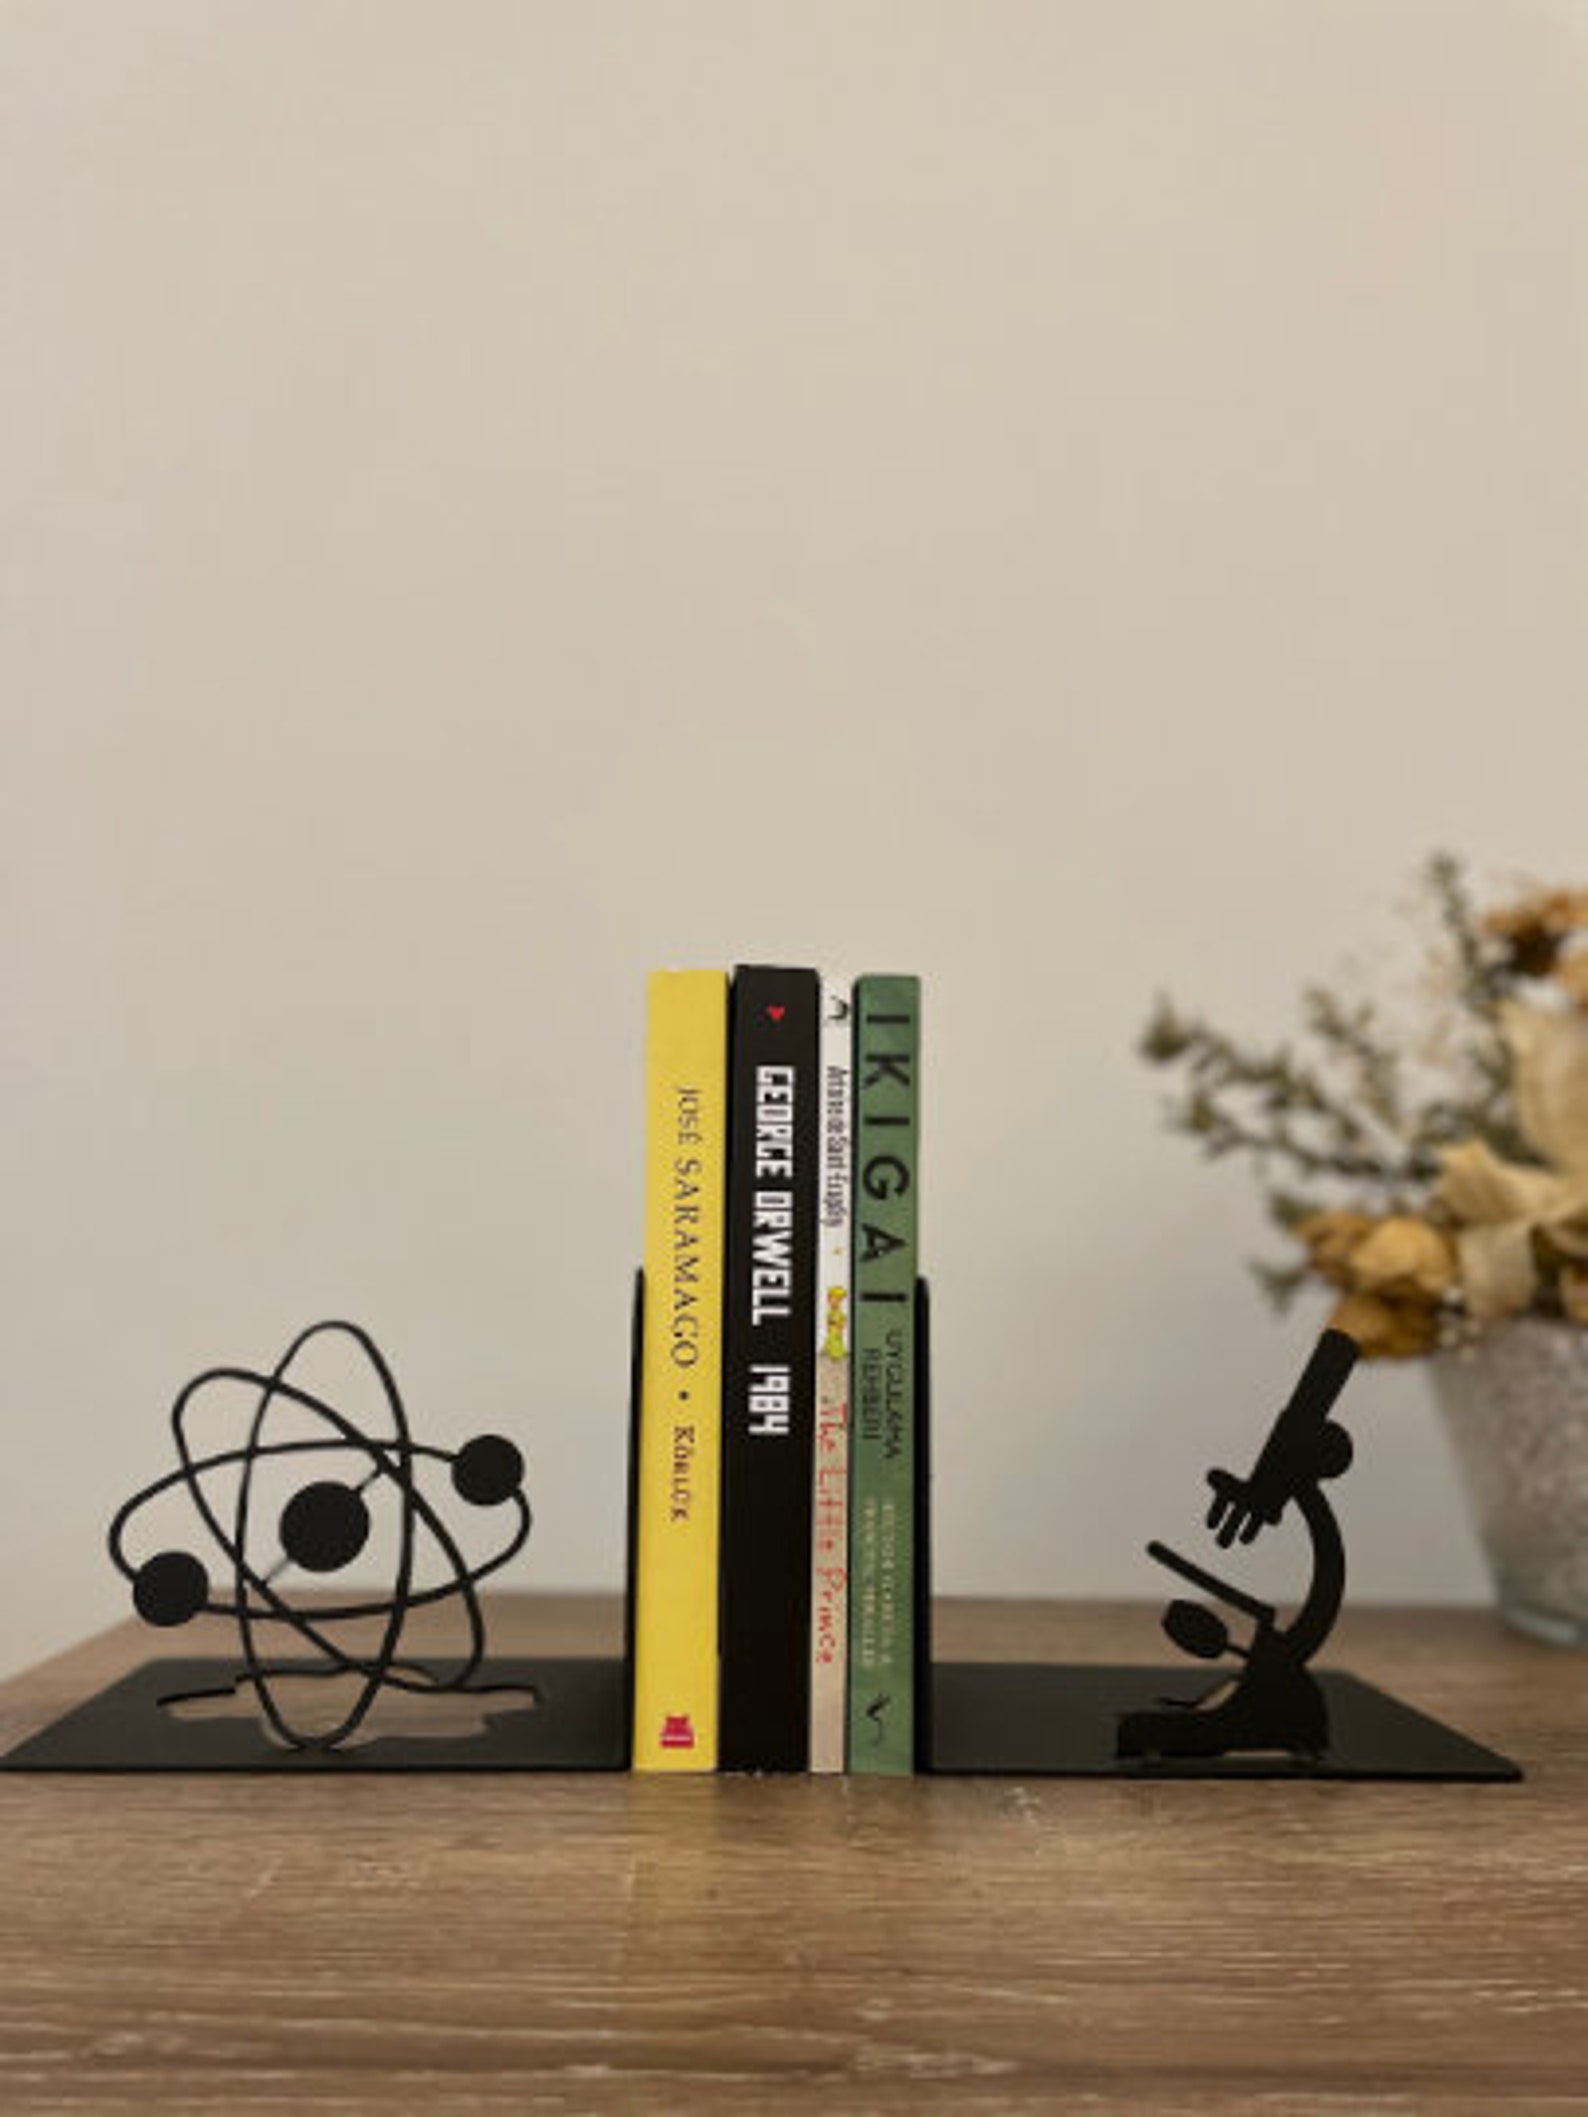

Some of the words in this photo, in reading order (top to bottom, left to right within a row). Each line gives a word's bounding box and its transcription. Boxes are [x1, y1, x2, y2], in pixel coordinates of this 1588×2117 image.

[676, 1086, 703, 1146] JOSÉ
[755, 1065, 794, 1178] GEORGE
[860, 1013, 911, 1302] IKIGAI
[671, 1158, 701, 1368] SARAMAGO
[751, 1190, 791, 1326] ORWELL
[748, 1363, 790, 1436] 1984
[816, 1403, 849, 1454] The
[817, 1466, 848, 1553] Little
[815, 1566, 849, 1665] Prince
